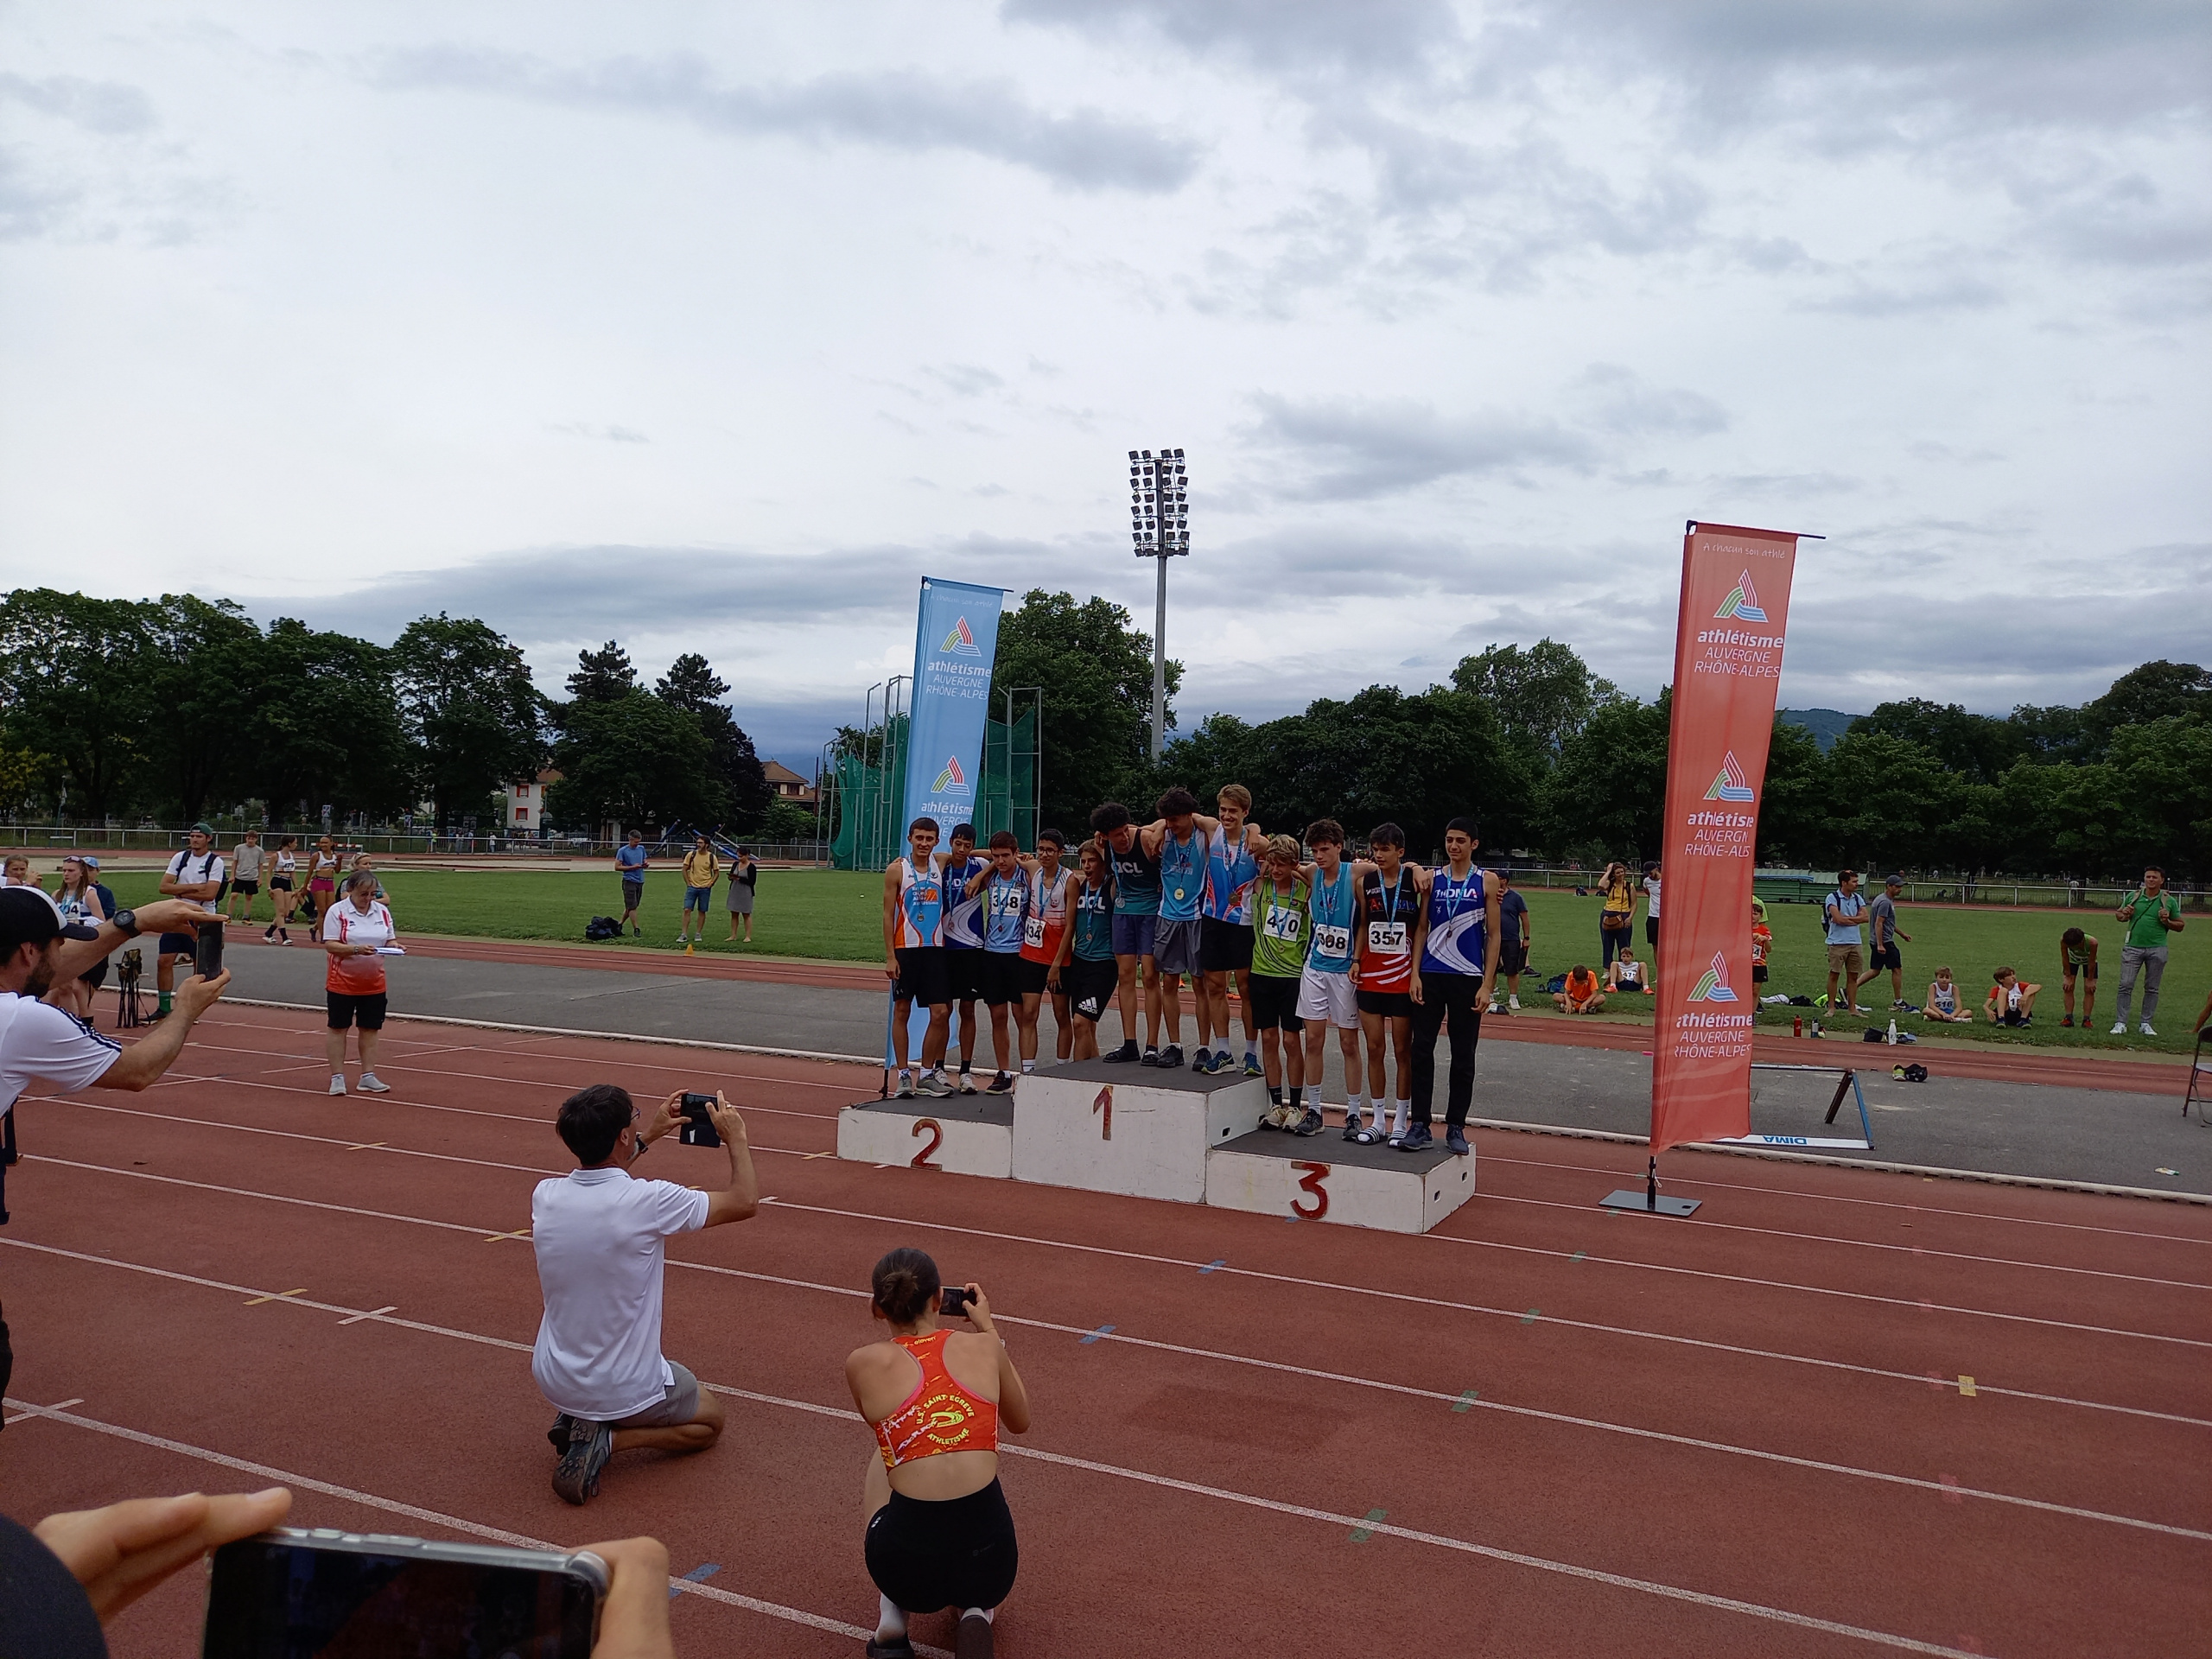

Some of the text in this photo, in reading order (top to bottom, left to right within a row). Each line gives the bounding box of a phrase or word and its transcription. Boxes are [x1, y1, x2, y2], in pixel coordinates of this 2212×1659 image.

[1713, 544, 1743, 554] chacun
[1745, 548, 1758, 556] son
[1762, 549, 1785, 559] athlé
[1697, 629, 1784, 648] athlétisme
[1705, 647, 1771, 664] AUVERGNE
[928, 660, 992, 677] athlétisme
[1694, 660, 1780, 677] RHÔNE-ALPES
[933, 674, 983, 689] AUVERGNE
[926, 684, 989, 700] RHÔNE-ALPES
[1694, 829, 1748, 842] AUVERGN
[1371, 931, 1403, 945] 357
[1680, 1030, 1745, 1043] AUVERGNE
[1093, 1085, 1113, 1141] 1
[911, 1118, 944, 1171] 2
[1763, 1135, 1808, 1145] DIMA
[1290, 1160, 1331, 1220] 3
[926, 1427, 969, 1445] ATHLETISME
